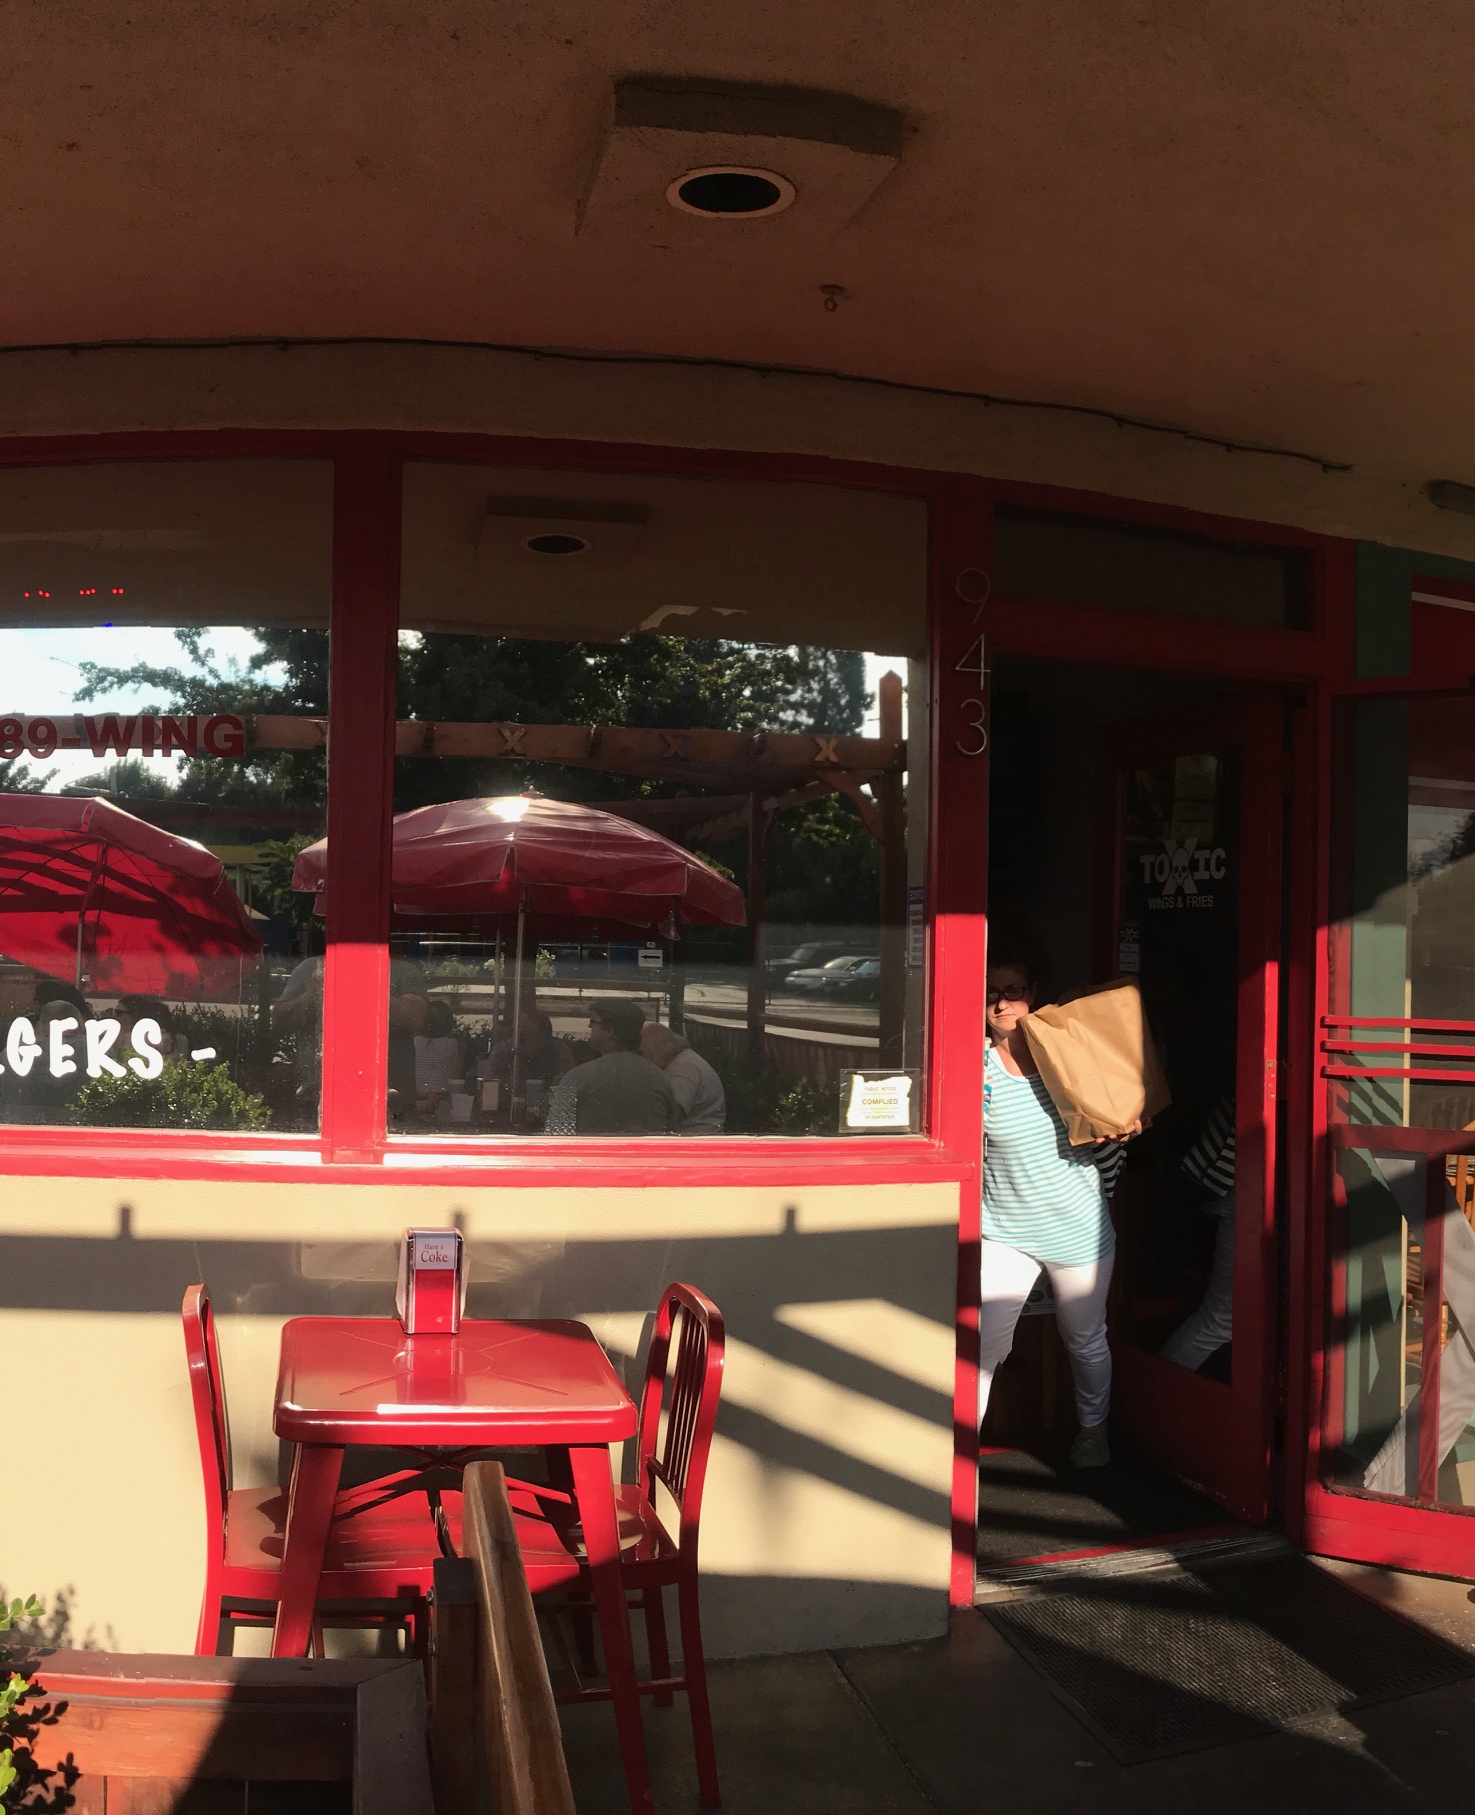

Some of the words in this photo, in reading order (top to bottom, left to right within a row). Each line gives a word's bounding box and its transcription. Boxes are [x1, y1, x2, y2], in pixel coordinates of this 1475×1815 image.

[955, 567, 991, 755] 943
[1139, 837, 1227, 895] TOXIC
[1148, 896, 1175, 910] WINGS
[1176, 896, 1183, 908] &
[1186, 894, 1214, 908] FRIES
[421, 1250, 448, 1263] Coke
